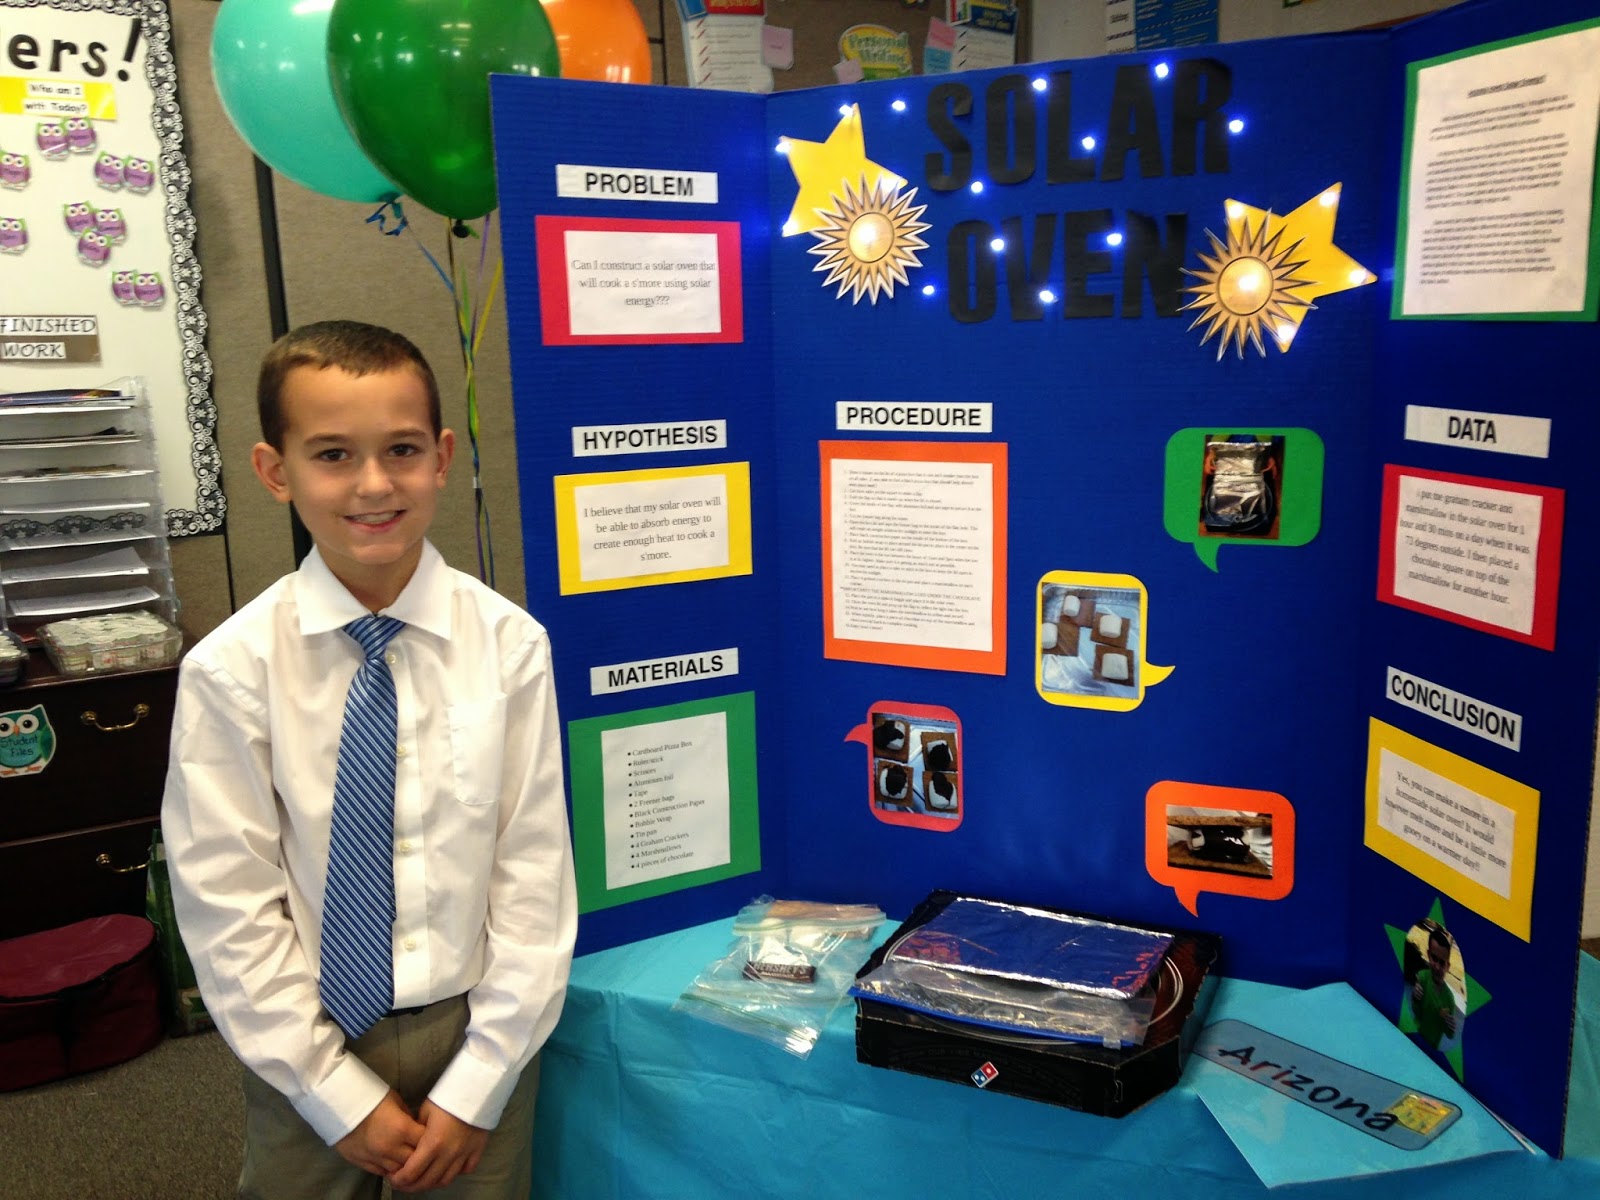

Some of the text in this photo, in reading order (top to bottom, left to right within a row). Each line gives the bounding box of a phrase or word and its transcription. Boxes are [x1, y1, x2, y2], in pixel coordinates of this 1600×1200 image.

[8, 18, 141, 81] ers!
[924, 57, 1232, 191] SOLAR
[585, 172, 694, 197] PROBLEM
[572, 260, 593, 270] Can
[594, 260, 598, 270] I
[600, 261, 642, 270] construct
[652, 260, 674, 270] solar
[700, 261, 716, 270] that
[946, 209, 1188, 323] OVEN
[580, 278, 598, 288] will
[600, 278, 622, 288] cook
[632, 278, 662, 288] s'more
[664, 279, 688, 290] using
[690, 279, 712, 288] solar
[625, 295, 670, 308] energy???
[3, 342, 63, 358] WORK
[846, 407, 982, 427] PROCEDURE
[583, 425, 718, 450] HYPOTHESIS
[1447, 415, 1498, 444] DATA
[584, 496, 722, 518] I believe that my solar oven will
[596, 514, 712, 533] be able to absorb energy to
[1406, 504, 1447, 518] marshmallow
[1450, 512, 1456, 520] in
[1458, 512, 1468, 524] the
[1470, 516, 1487, 527] solar
[1488, 520, 1506, 531] oven
[1508, 521, 1518, 533] for
[594, 530, 716, 550] create enough heat to cook a
[1400, 519, 1530, 554] hour and 30 mins on a day when it was
[640, 550, 672, 561] s'more.
[1414, 538, 1439, 552] degrees
[1440, 545, 1466, 558] outside.
[1467, 550, 1472, 559] I
[1472, 550, 1488, 562] then
[1488, 555, 1514, 568] placed
[1514, 562, 1520, 570] a
[1411, 554, 1510, 586] chocolate square on top of the
[1408, 570, 1510, 604] marshmallow for another hour.
[608, 655, 724, 687] MATERIALS
[1391, 674, 1516, 742] CONCLUSION
[0, 734, 38, 748] Student
[632, 746, 664, 756] Cardboard
[634, 777, 664, 787] Aluminum
[634, 790, 648, 798] Tape
[640, 798, 660, 806] Freezer
[662, 795, 675, 803] bags
[1396, 770, 1410, 786] Yes,
[1410, 780, 1424, 792] you
[1424, 786, 1434, 798] can
[1435, 792, 1454, 808] make
[1454, 802, 1459, 810] a
[1482, 814, 1490, 826] in
[1490, 820, 1496, 828] a
[634, 800, 705, 818] Black Construction Paper
[1396, 786, 1428, 811] homemade
[1430, 805, 1446, 820] solar
[1472, 828, 1495, 845] would
[635, 819, 656, 828] Bubble
[1384, 796, 1409, 816] however
[1410, 811, 1424, 824] melt
[1424, 819, 1442, 834] more
[1442, 828, 1454, 841] and
[1455, 832, 1464, 846] be
[1470, 841, 1487, 858] little
[1488, 853, 1507, 868] more
[640, 838, 664, 848] Graham
[664, 832, 690, 842] Crackers
[641, 844, 682, 857] Marshmallows
[1403, 824, 1422, 840] gooey
[1422, 834, 1432, 845] on
[1432, 840, 1436, 848] a
[1436, 842, 1462, 862] warmer
[641, 860, 660, 868] pieces
[660, 856, 668, 864] of
[668, 851, 694, 862] chocolate
[1217, 1045, 1398, 1132] Arizona
